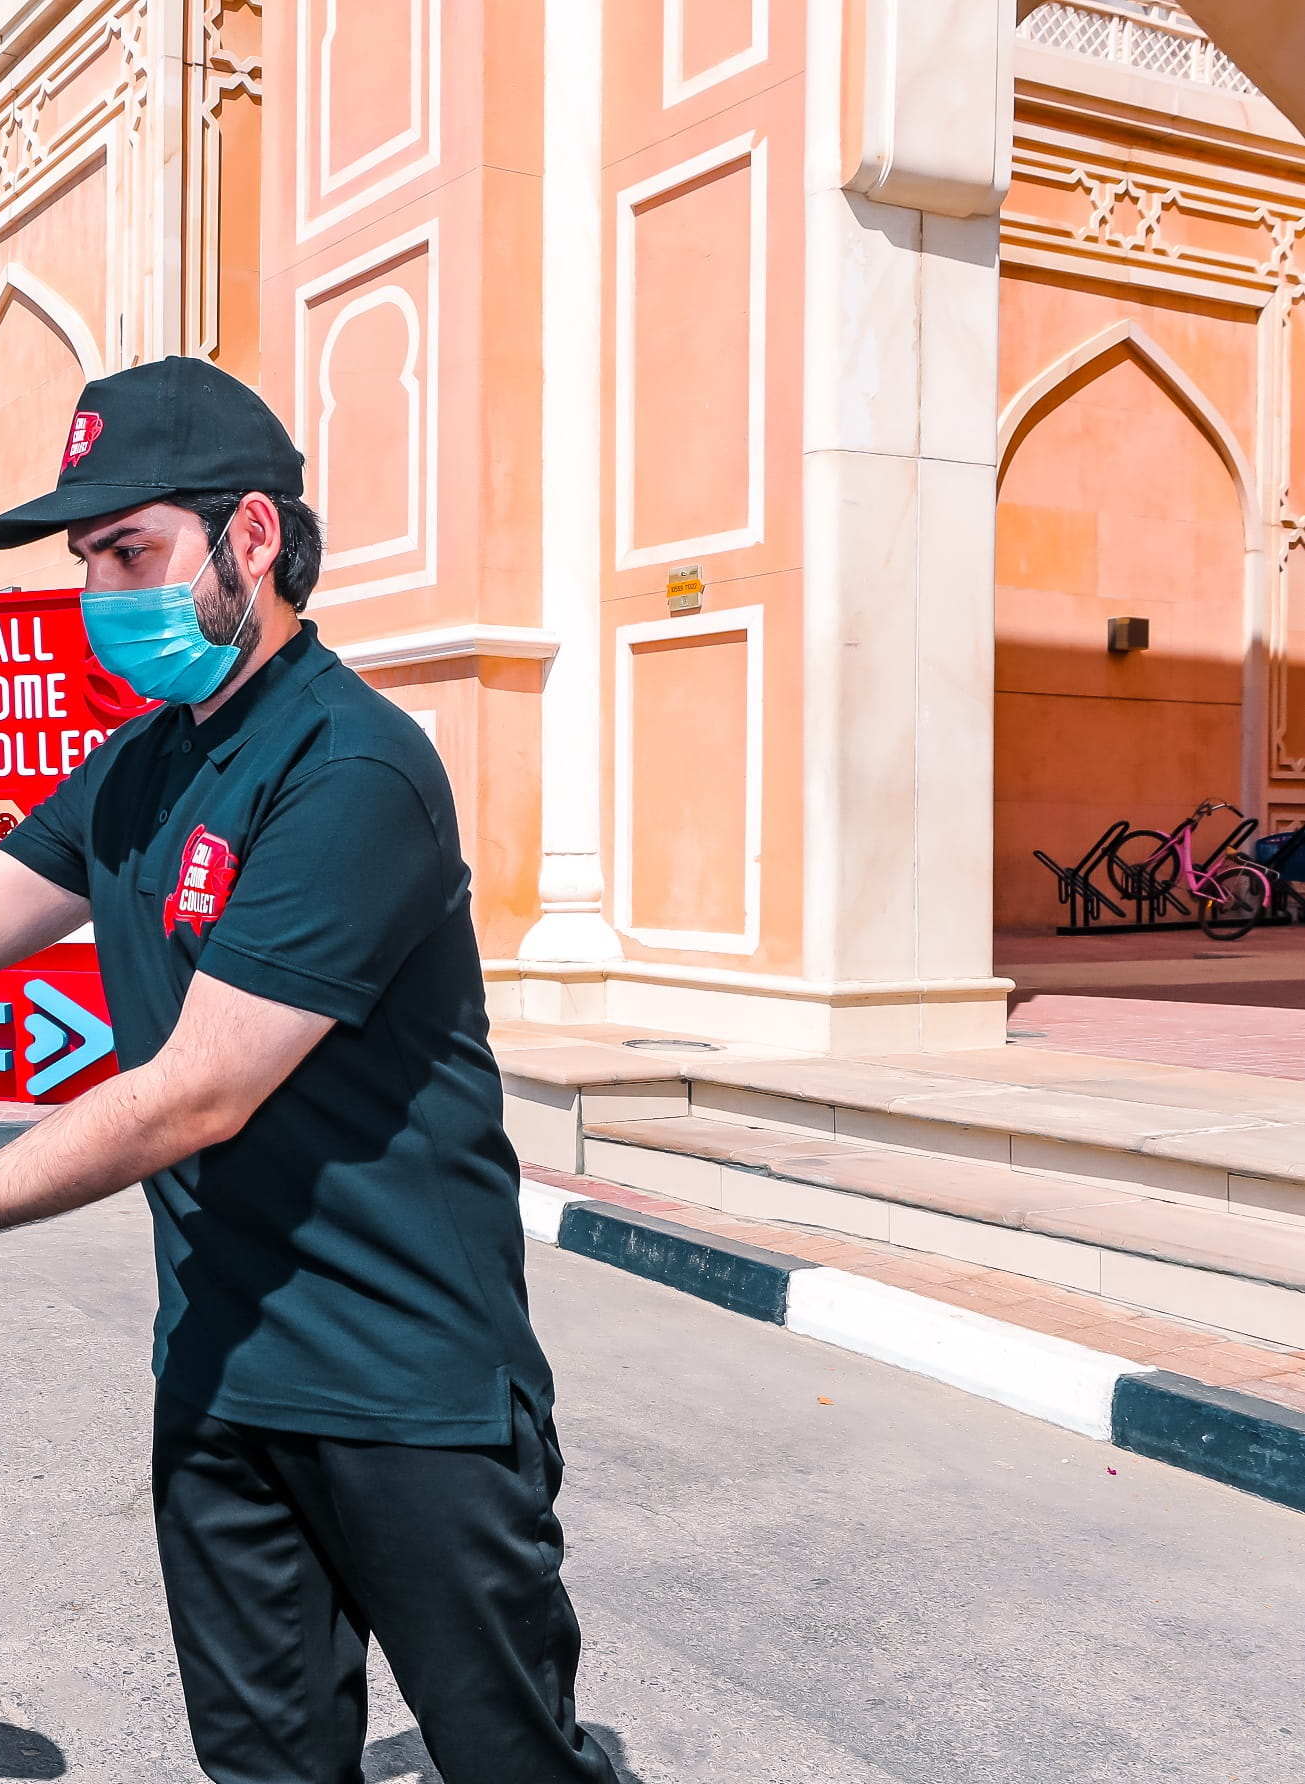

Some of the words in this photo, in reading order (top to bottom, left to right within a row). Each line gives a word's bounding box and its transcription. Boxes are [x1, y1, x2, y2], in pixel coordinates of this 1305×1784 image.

[192, 842, 213, 867] CALL
[184, 865, 210, 889] COME
[179, 888, 216, 914] COLLECT
